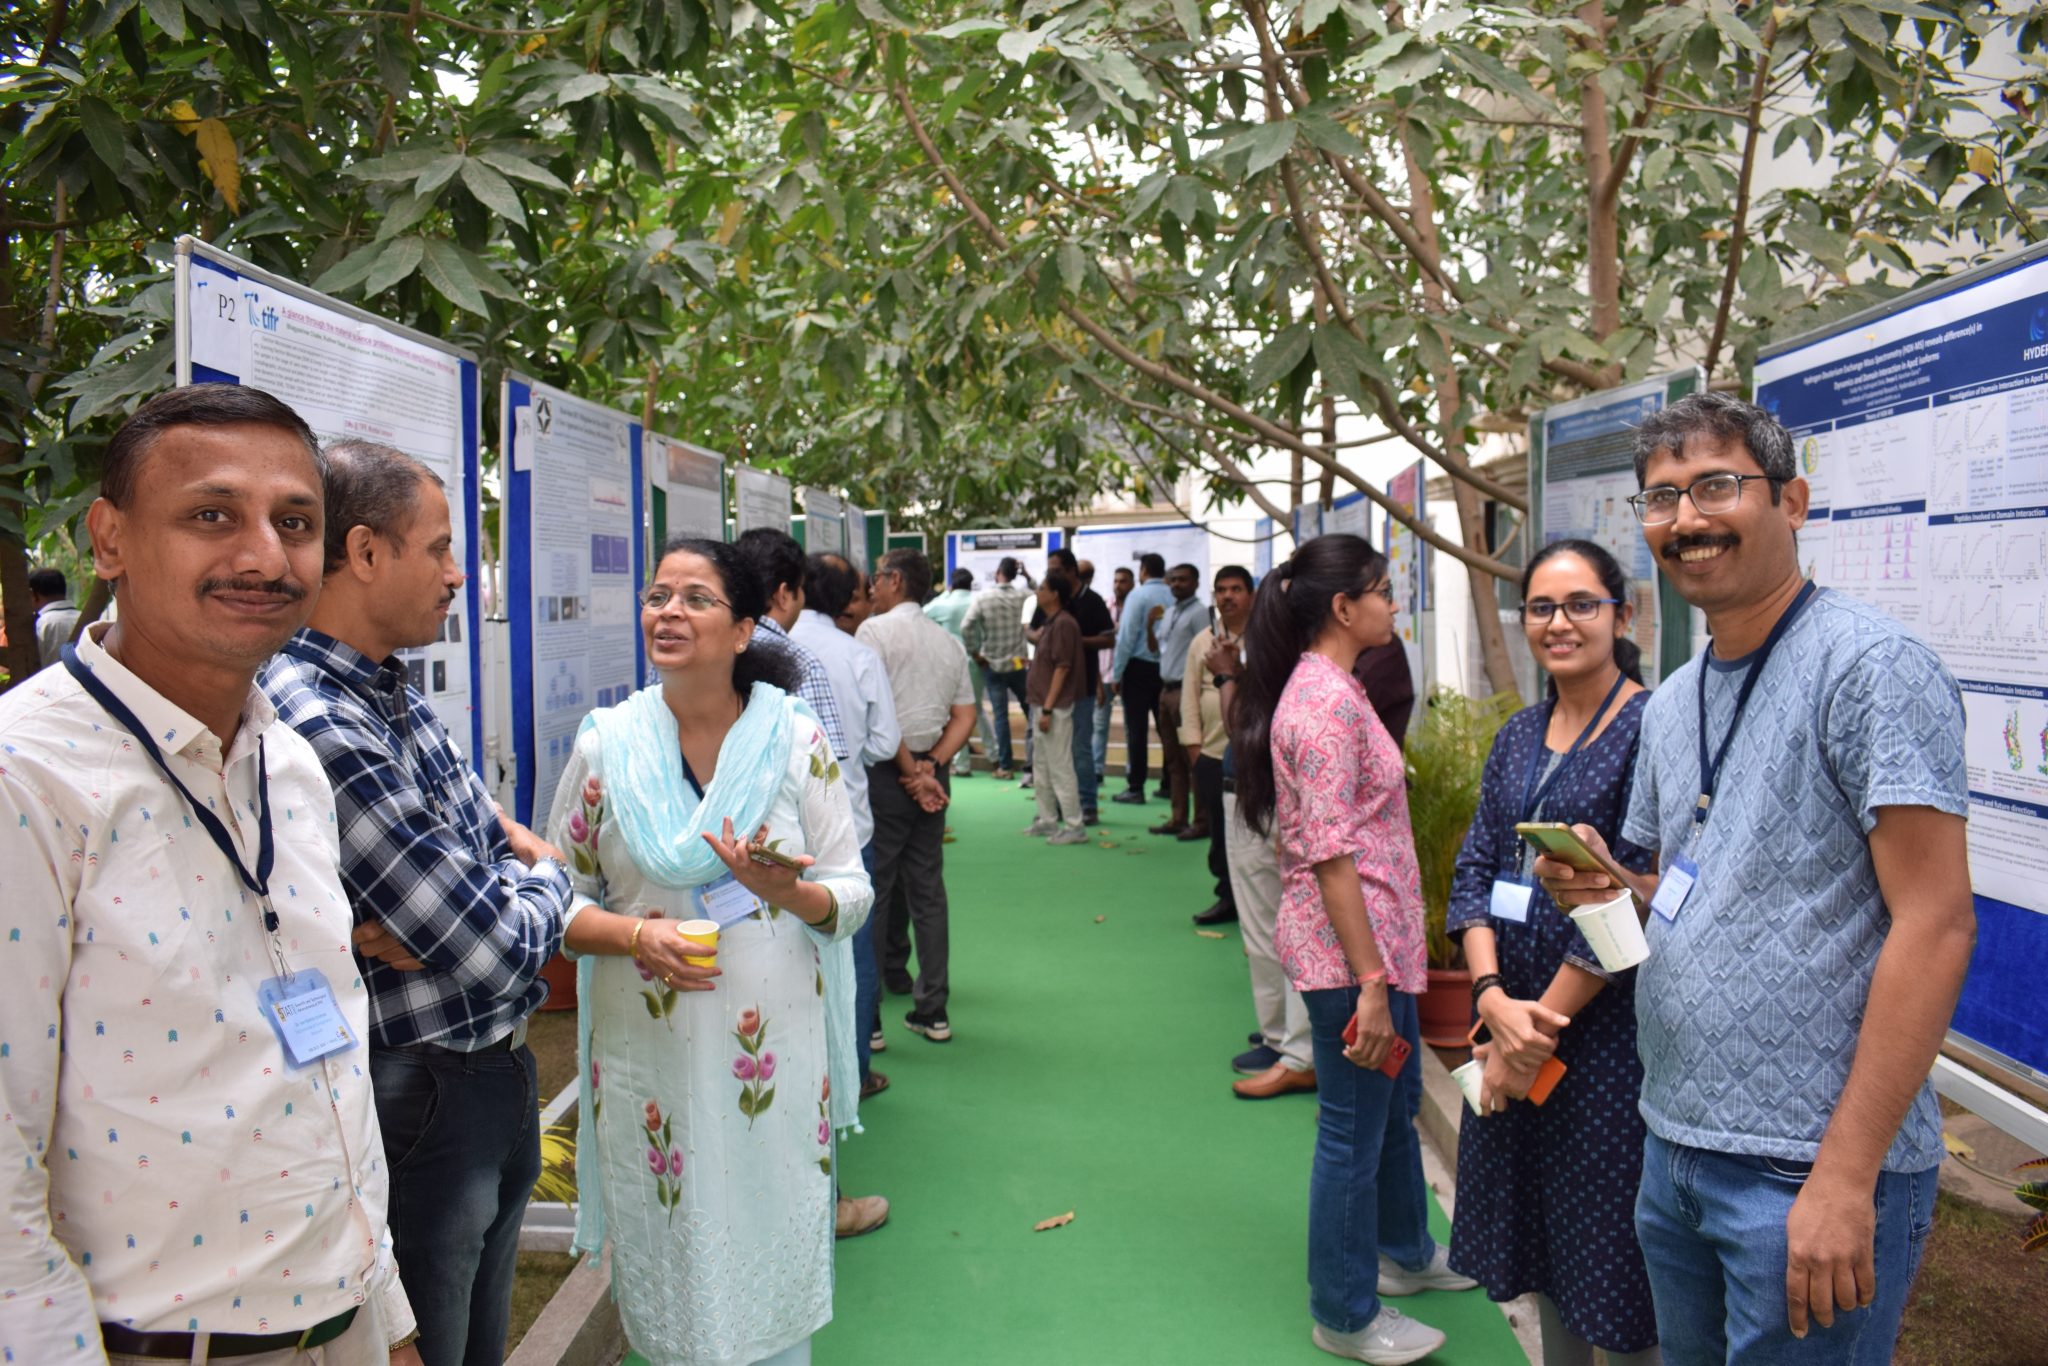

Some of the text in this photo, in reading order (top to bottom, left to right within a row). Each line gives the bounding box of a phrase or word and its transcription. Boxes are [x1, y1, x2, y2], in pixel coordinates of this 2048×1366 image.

[218, 293, 235, 322] P2
[262, 305, 279, 332] tifr
[1976, 322, 1983, 332] in
[2015, 508, 2046, 518] Interaction
[1994, 685, 2015, 695] Domain
[2015, 687, 2044, 697] Interaction
[1994, 800, 2010, 812] future
[2010, 804, 2037, 817] directions
